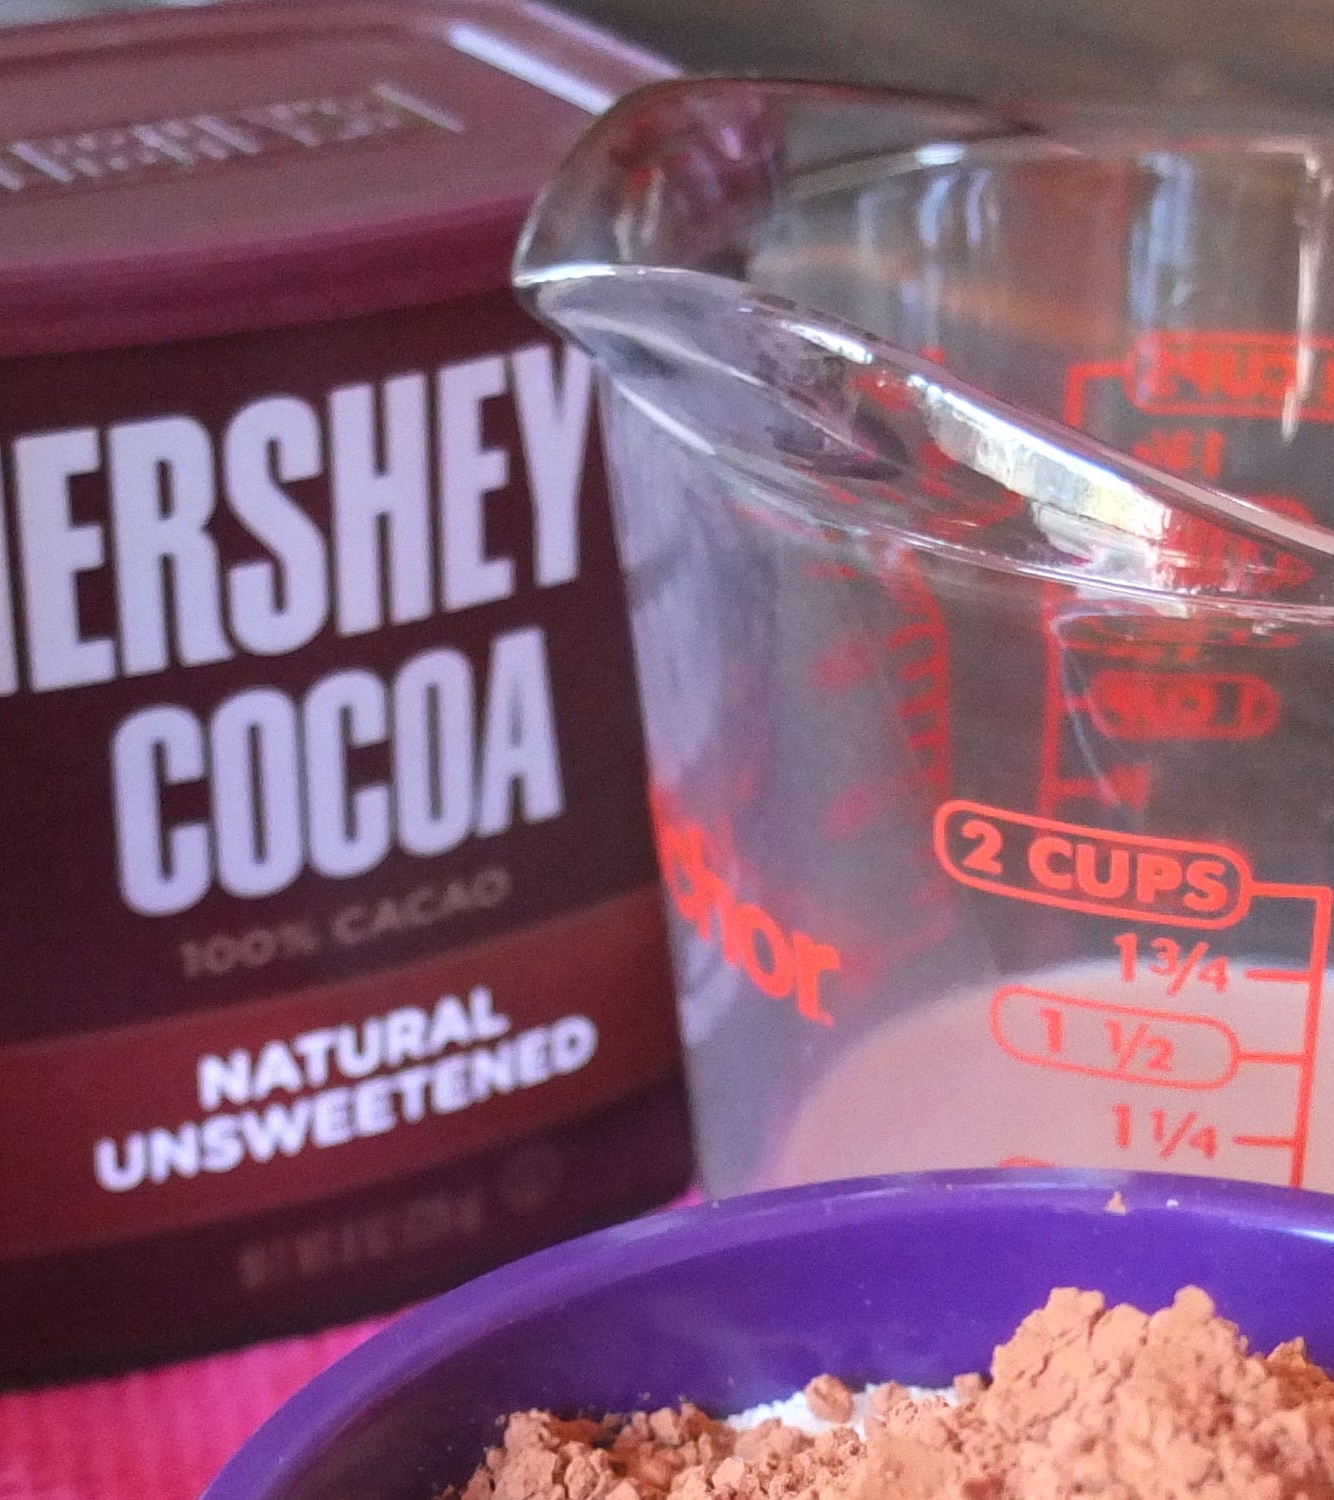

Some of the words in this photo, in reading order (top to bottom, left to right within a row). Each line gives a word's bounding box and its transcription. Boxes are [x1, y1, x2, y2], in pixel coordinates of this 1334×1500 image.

[112, 627, 564, 917] COCOA
[331, 866, 513, 945] CACAO
[961, 819, 1004, 876] 2
[1028, 835, 1229, 912] CUPS
[93, 1014, 600, 1193] UNSWEETENED
[197, 983, 513, 1112] NATURAL
